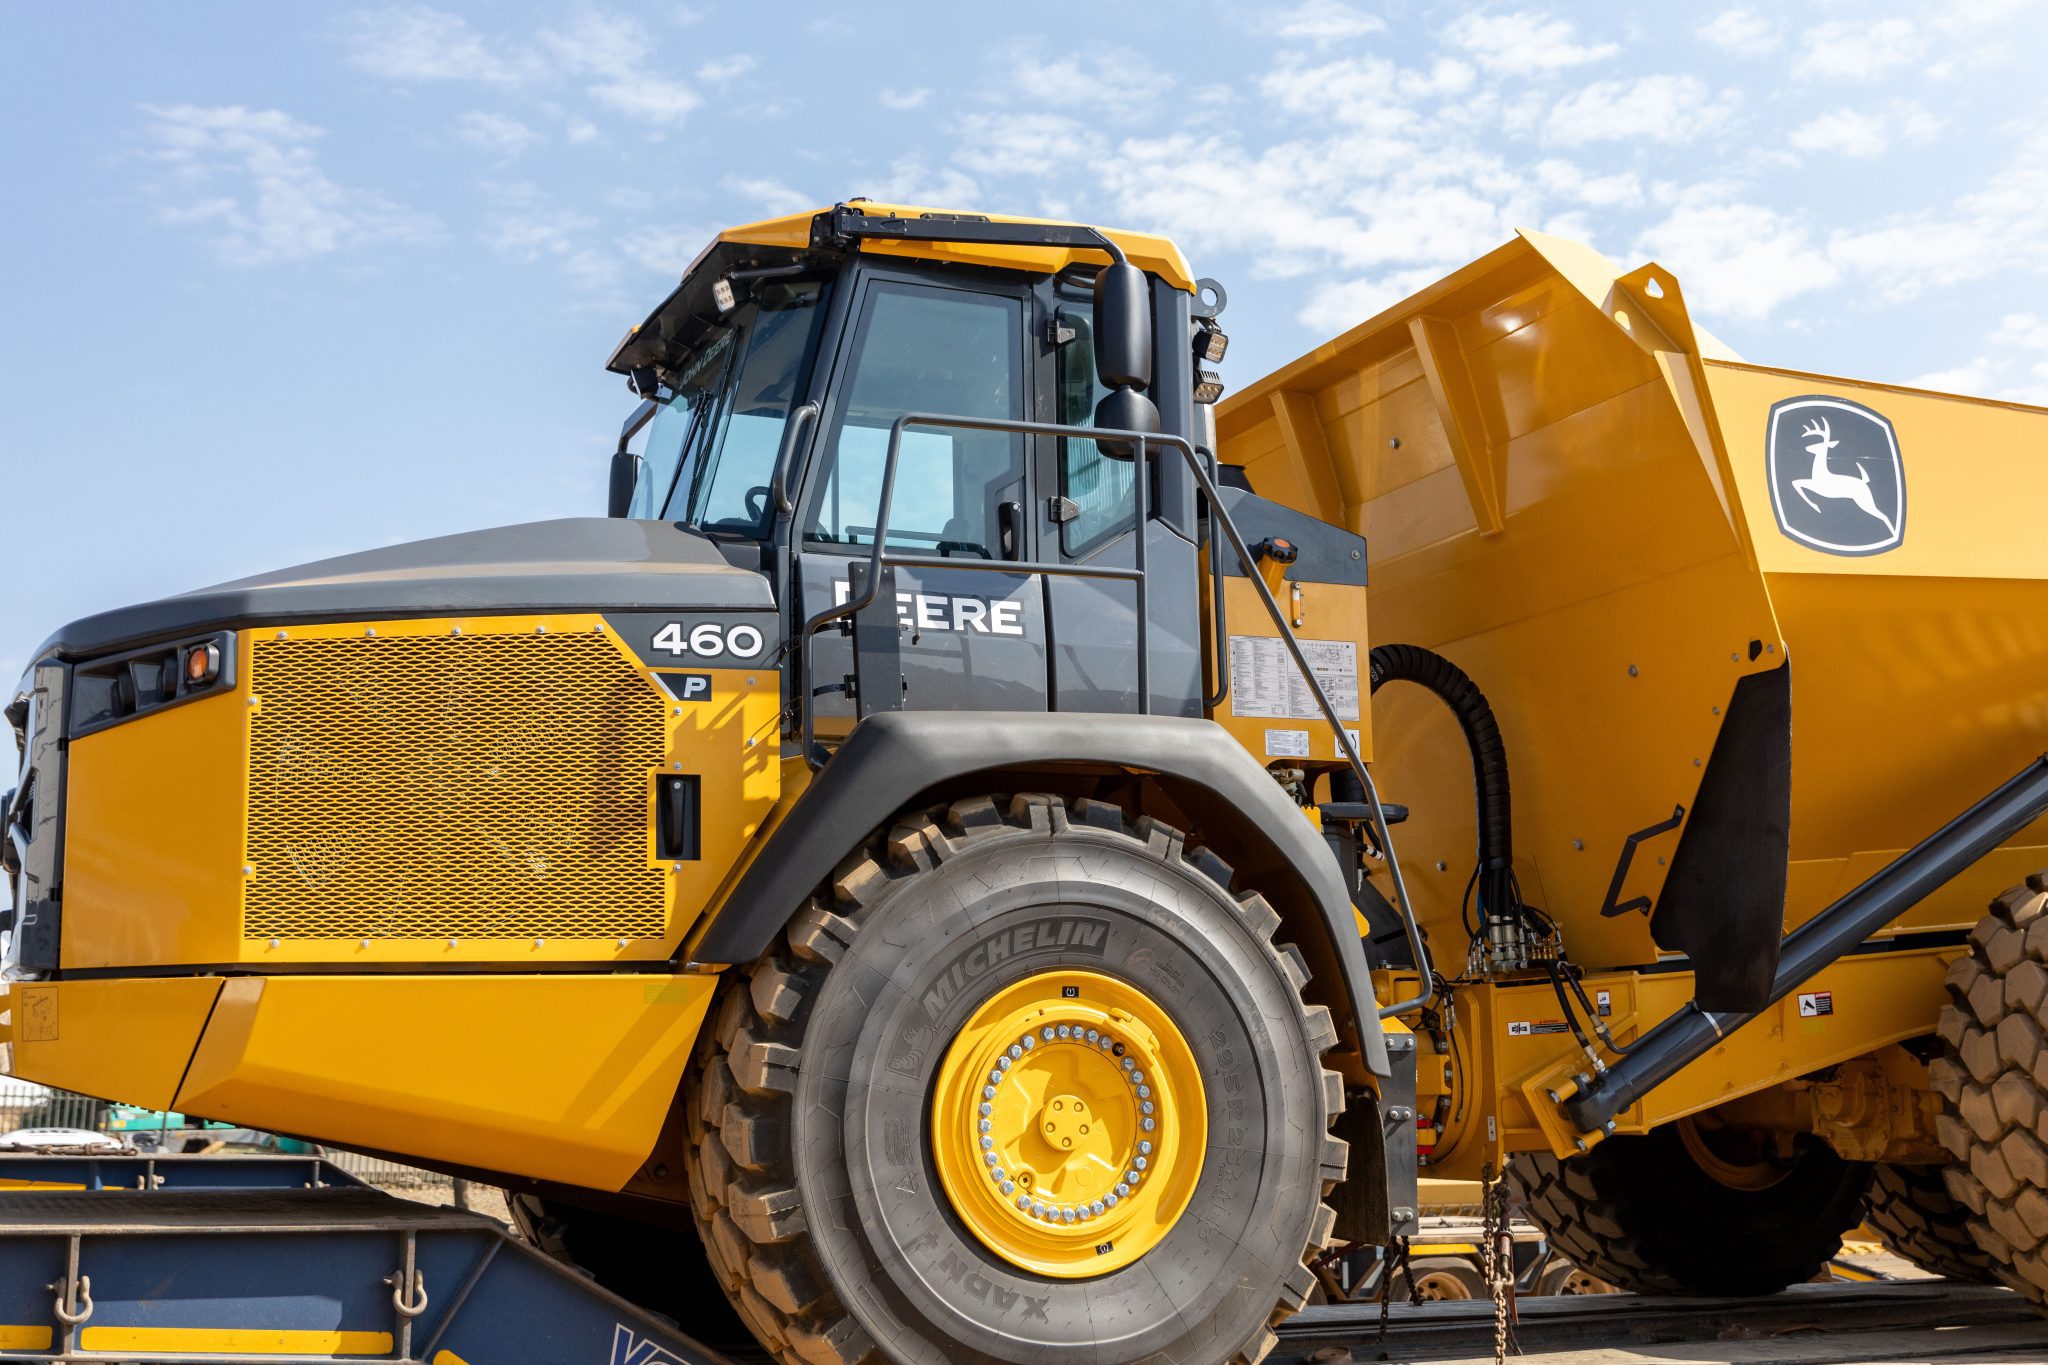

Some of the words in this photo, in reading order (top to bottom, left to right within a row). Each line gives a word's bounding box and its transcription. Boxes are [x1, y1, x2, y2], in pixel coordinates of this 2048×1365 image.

[702, 328, 734, 368] DEERE
[652, 623, 763, 658] 460
[683, 676, 707, 698] P
[923, 921, 1106, 1021] MICHELIN
[939, 1248, 1050, 1323] XADN
